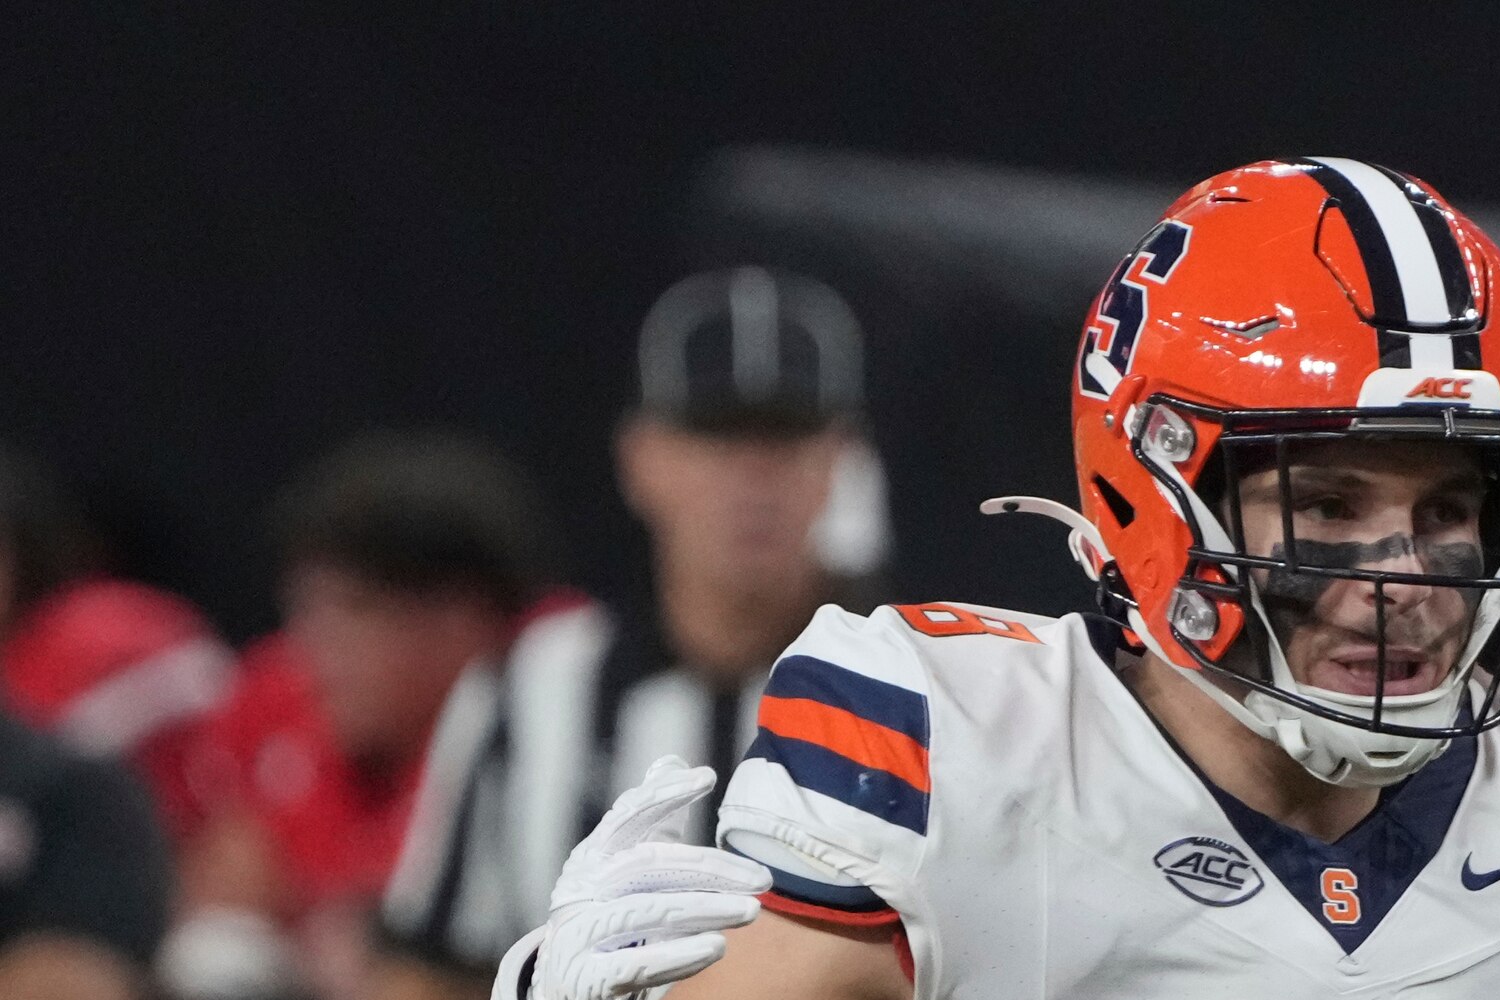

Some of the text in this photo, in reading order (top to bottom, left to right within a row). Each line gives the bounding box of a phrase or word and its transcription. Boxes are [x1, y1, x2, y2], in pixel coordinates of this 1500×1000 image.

[1405, 376, 1474, 399] ACC
[1169, 851, 1251, 885] ACC
[1319, 867, 1362, 925] S
